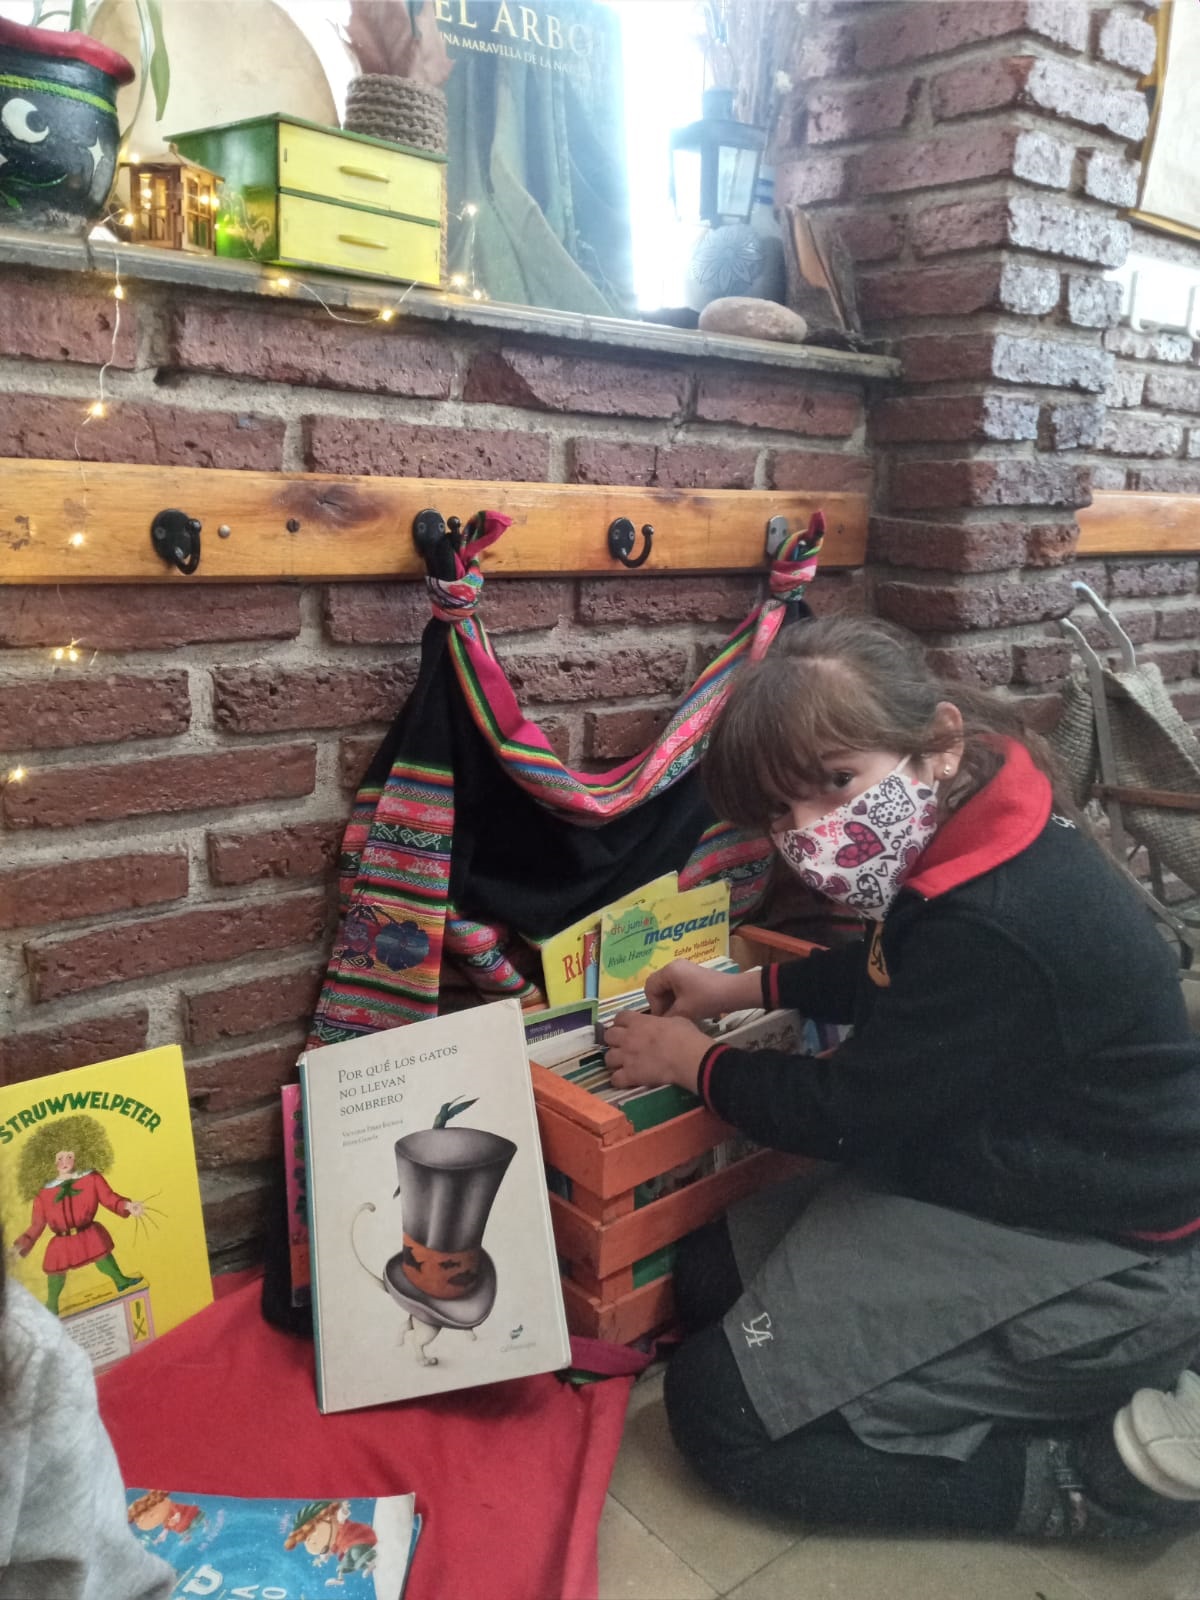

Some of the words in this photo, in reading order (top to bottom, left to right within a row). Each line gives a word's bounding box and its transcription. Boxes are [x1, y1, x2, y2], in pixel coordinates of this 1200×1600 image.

[462, 38, 521, 60] MARAVILLA
[524, 52, 537, 65] DE
[540, 56, 551, 69] LA
[880, 825, 912, 862] Love
[644, 908, 726, 946] magazin
[562, 952, 584, 983] Ri
[338, 1069, 363, 1084] POR
[365, 1059, 391, 1077] QUÉ
[395, 1056, 416, 1069] LOS
[419, 1045, 459, 1063] GATOS
[340, 1087, 357, 1100] NO
[361, 1075, 407, 1095] LLEVAN
[0, 1090, 162, 1145] STRUWWELPETER
[340, 1093, 404, 1117] SOMBRERO
